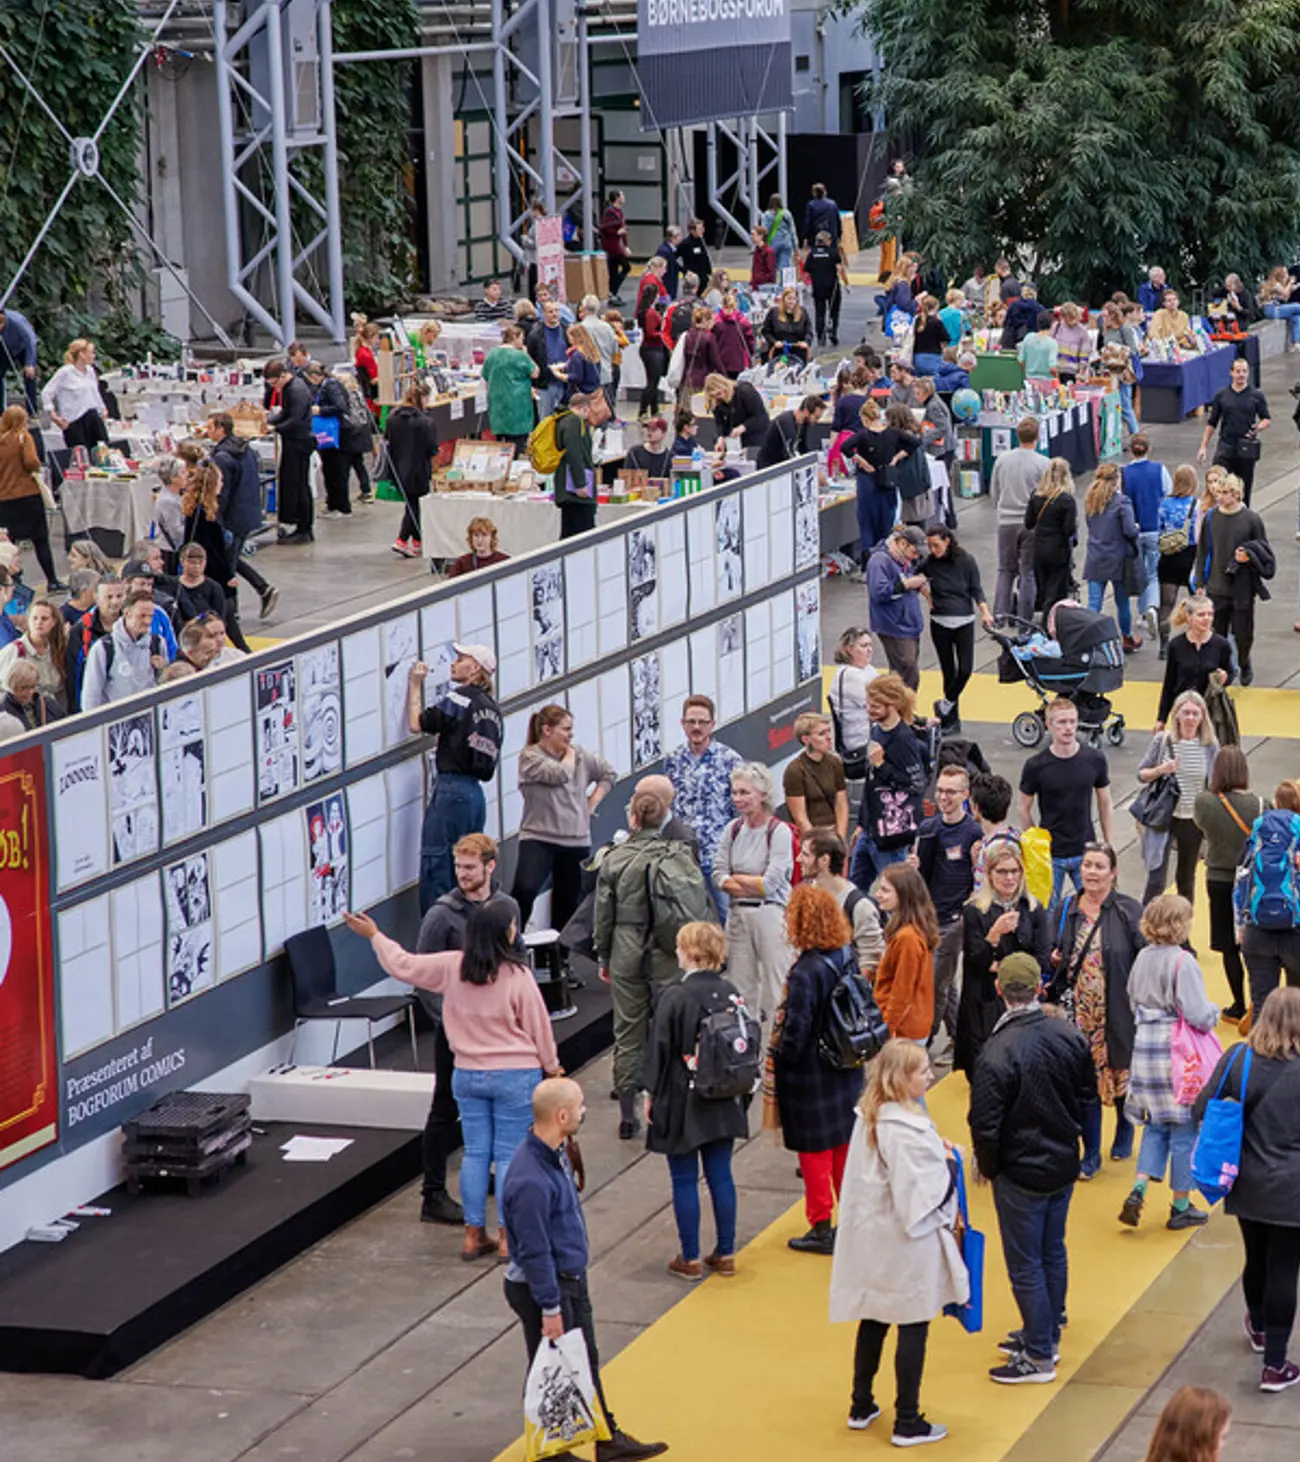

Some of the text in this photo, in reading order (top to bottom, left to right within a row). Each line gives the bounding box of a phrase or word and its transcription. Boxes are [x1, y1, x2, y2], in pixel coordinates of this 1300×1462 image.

[66, 1036, 154, 1100] Præsenteret af
[67, 1047, 186, 1128] BOGFORUM COMICS
